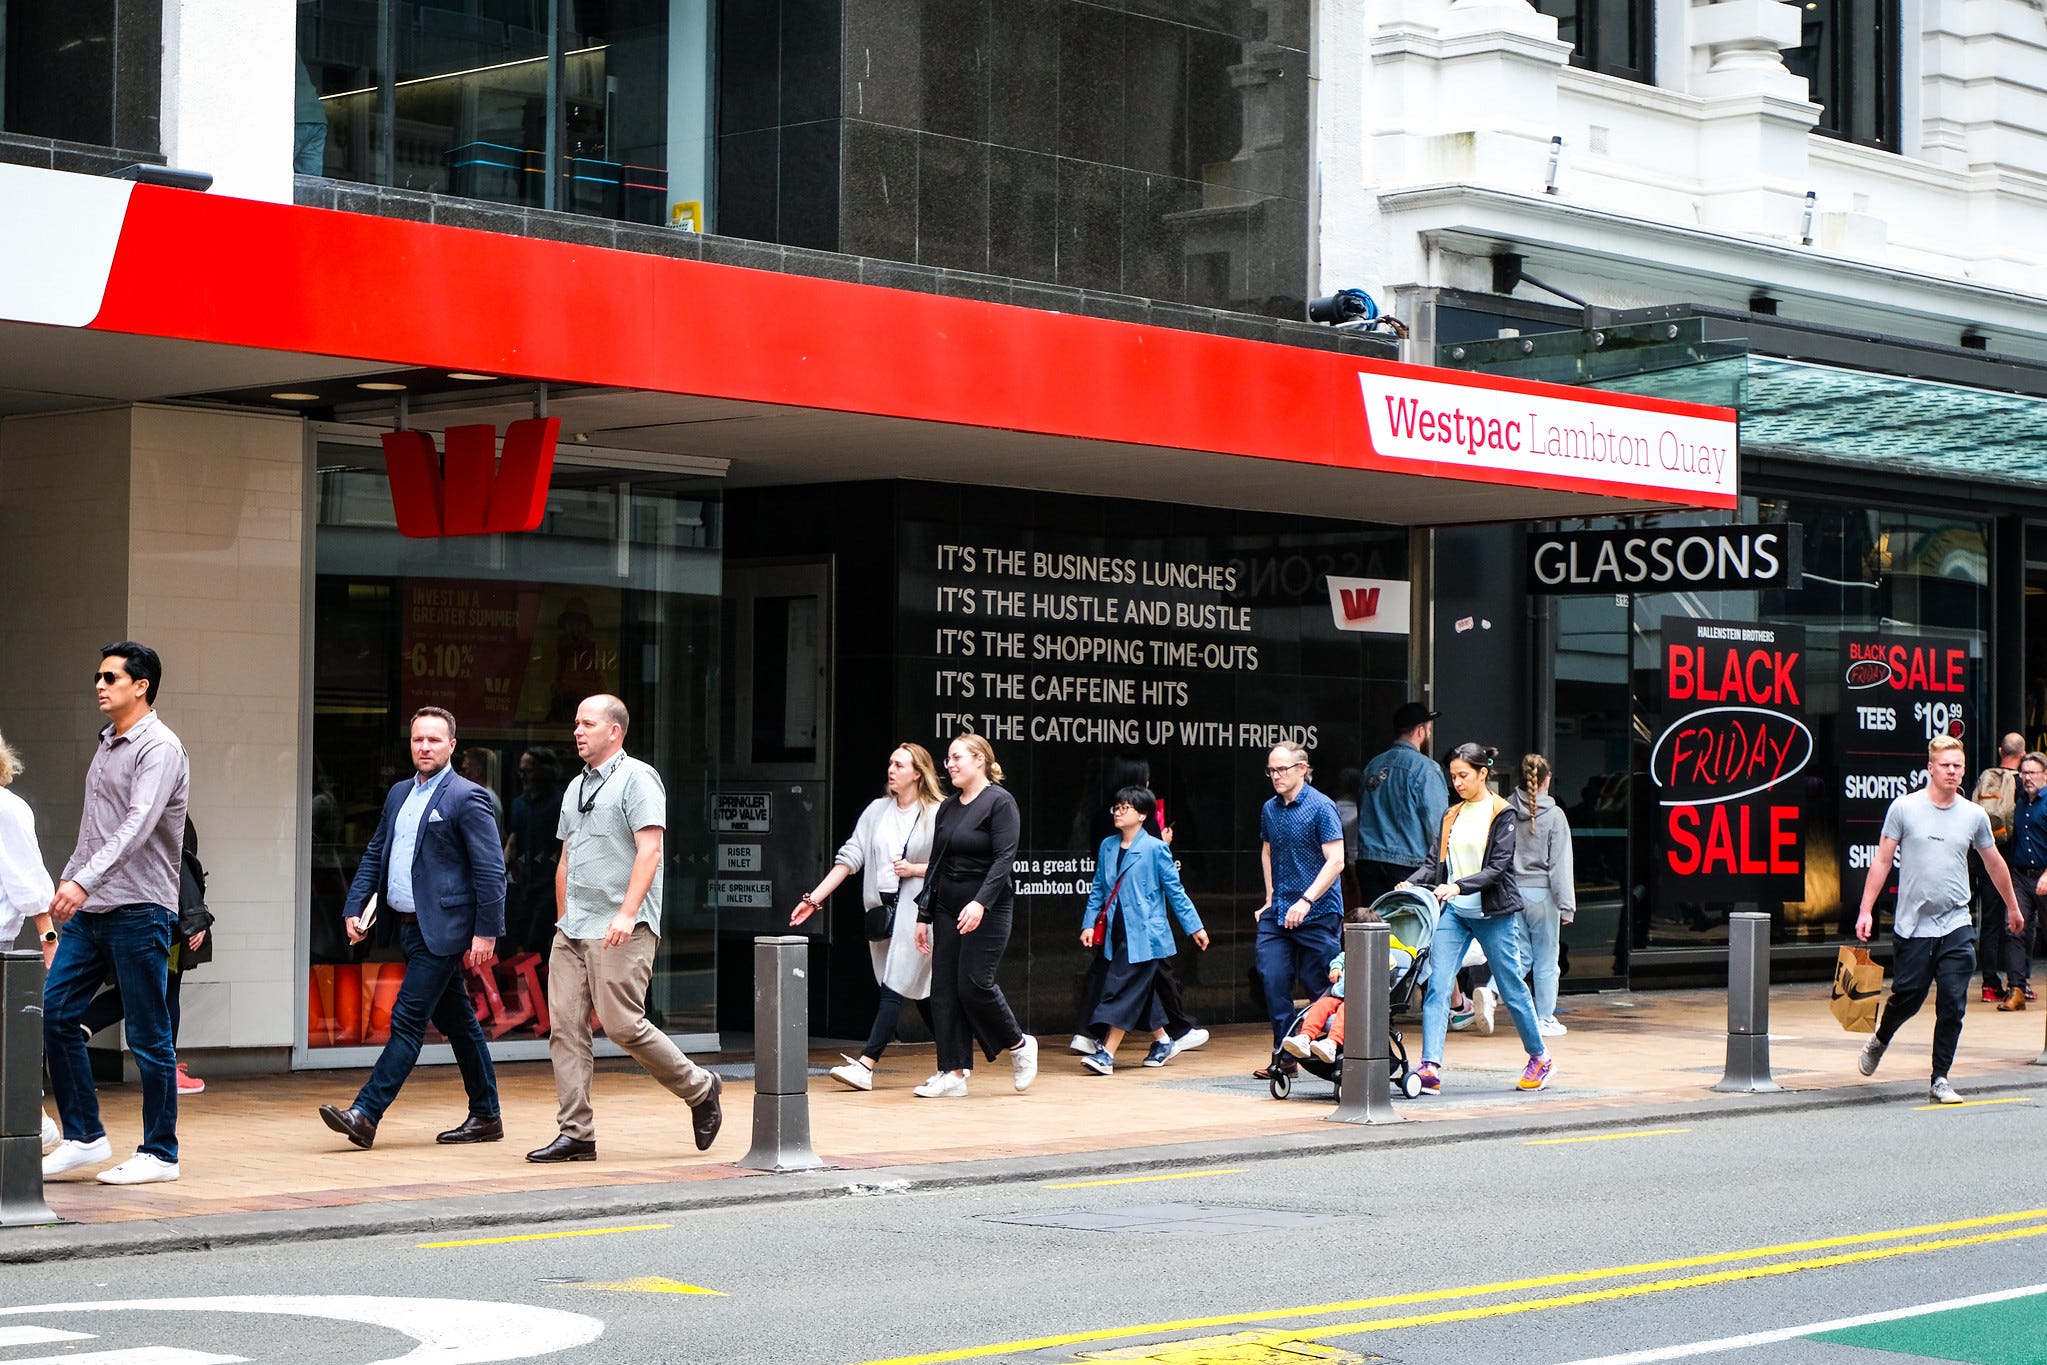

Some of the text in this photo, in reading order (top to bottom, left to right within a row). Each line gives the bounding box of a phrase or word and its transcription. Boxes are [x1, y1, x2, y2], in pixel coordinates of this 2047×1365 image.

[1385, 395, 1726, 485] Westpac Lambton Quay
[937, 544, 1237, 592] IT'S THE BUSINESS LUNCHES
[1534, 533, 1780, 585] GLASSONS
[413, 606, 519, 628] GREATER SUMMER
[937, 586, 1251, 631] IT'S THE HUSTLE AND BUSTLE
[1697, 626, 1775, 643] HALLENSTEIN BROTHERS
[936, 628, 1259, 671] IT'S THE SHOPPING TIME-OUTS
[1850, 643, 1886, 660] BLACK
[1669, 644, 1800, 705] BLACK
[1851, 664, 1888, 684] FRIDAY
[1889, 645, 1965, 692] SALE
[936, 671, 1189, 707] IT'S THE CAFFEINE HITS
[1856, 706, 1897, 731] TEES
[935, 713, 1318, 750] IT'S THE CATCHING UP WITH FRIENDS
[1671, 720, 1797, 791] FRIDAY
[1845, 775, 1908, 799] SHORTS
[739, 809, 767, 821] VALVE
[1667, 804, 1799, 875] SALE
[727, 847, 751, 857] RISER
[728, 858, 750, 868] INLET
[1849, 845, 1901, 868] SHIS
[1012, 860, 1030, 873] on
[1032, 861, 1040, 873] a
[1043, 858, 1078, 876] great
[709, 884, 770, 893] FIRE SPRINKLER
[726, 894, 753, 903] INLETS
[1015, 879, 1093, 895] Lambton Qu
